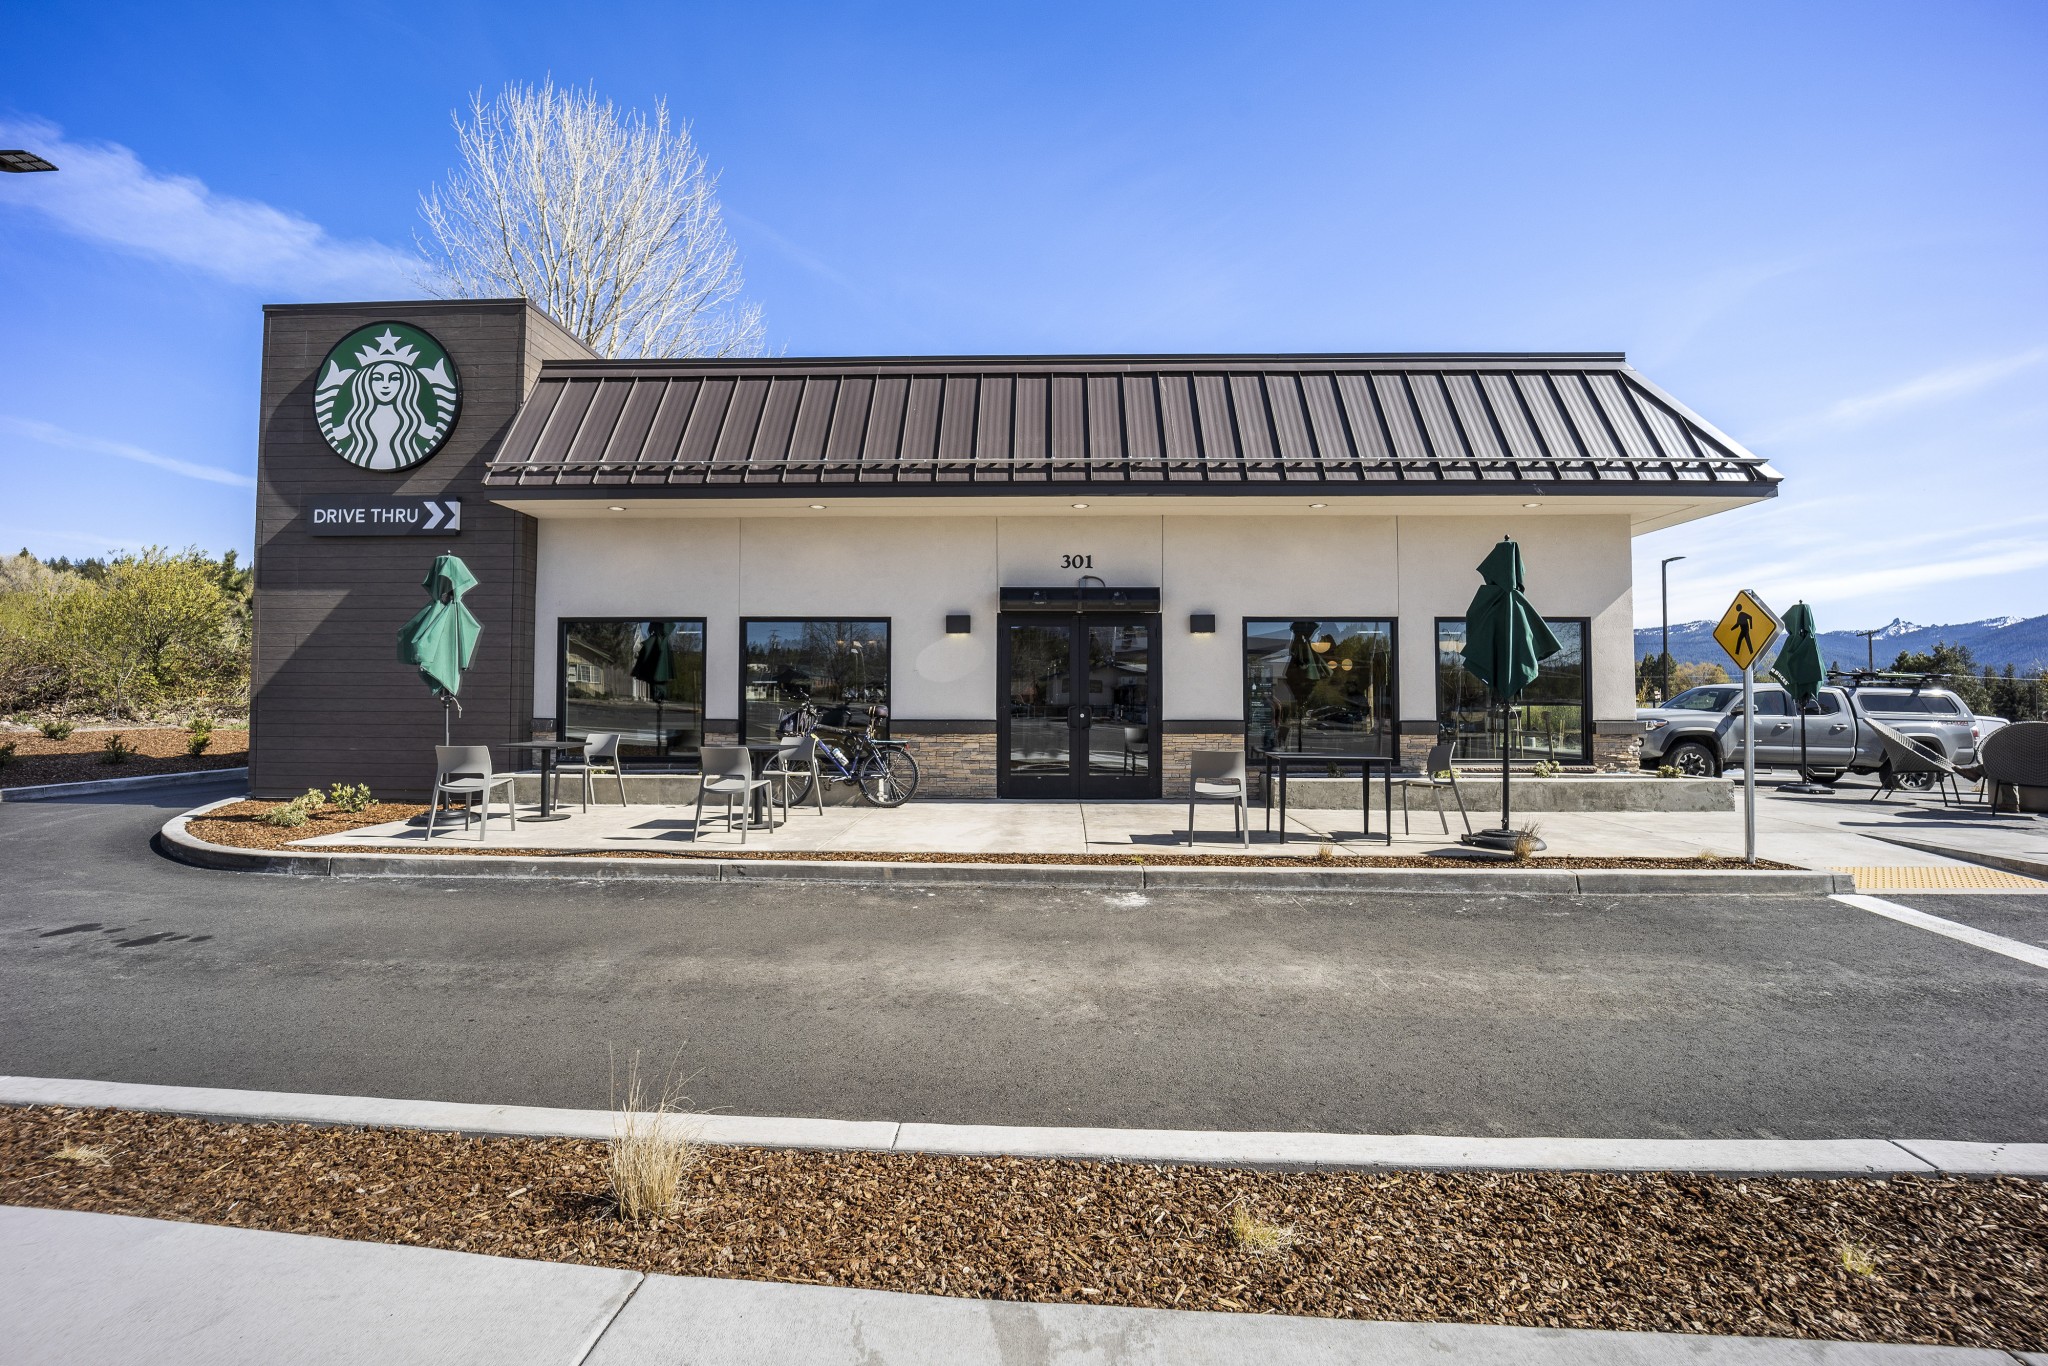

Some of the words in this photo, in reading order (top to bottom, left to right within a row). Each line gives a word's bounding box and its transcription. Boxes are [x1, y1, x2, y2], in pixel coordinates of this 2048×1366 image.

[314, 509, 365, 523] DRIVE
[371, 508, 418, 523] THRU
[1061, 554, 1094, 569] 301
